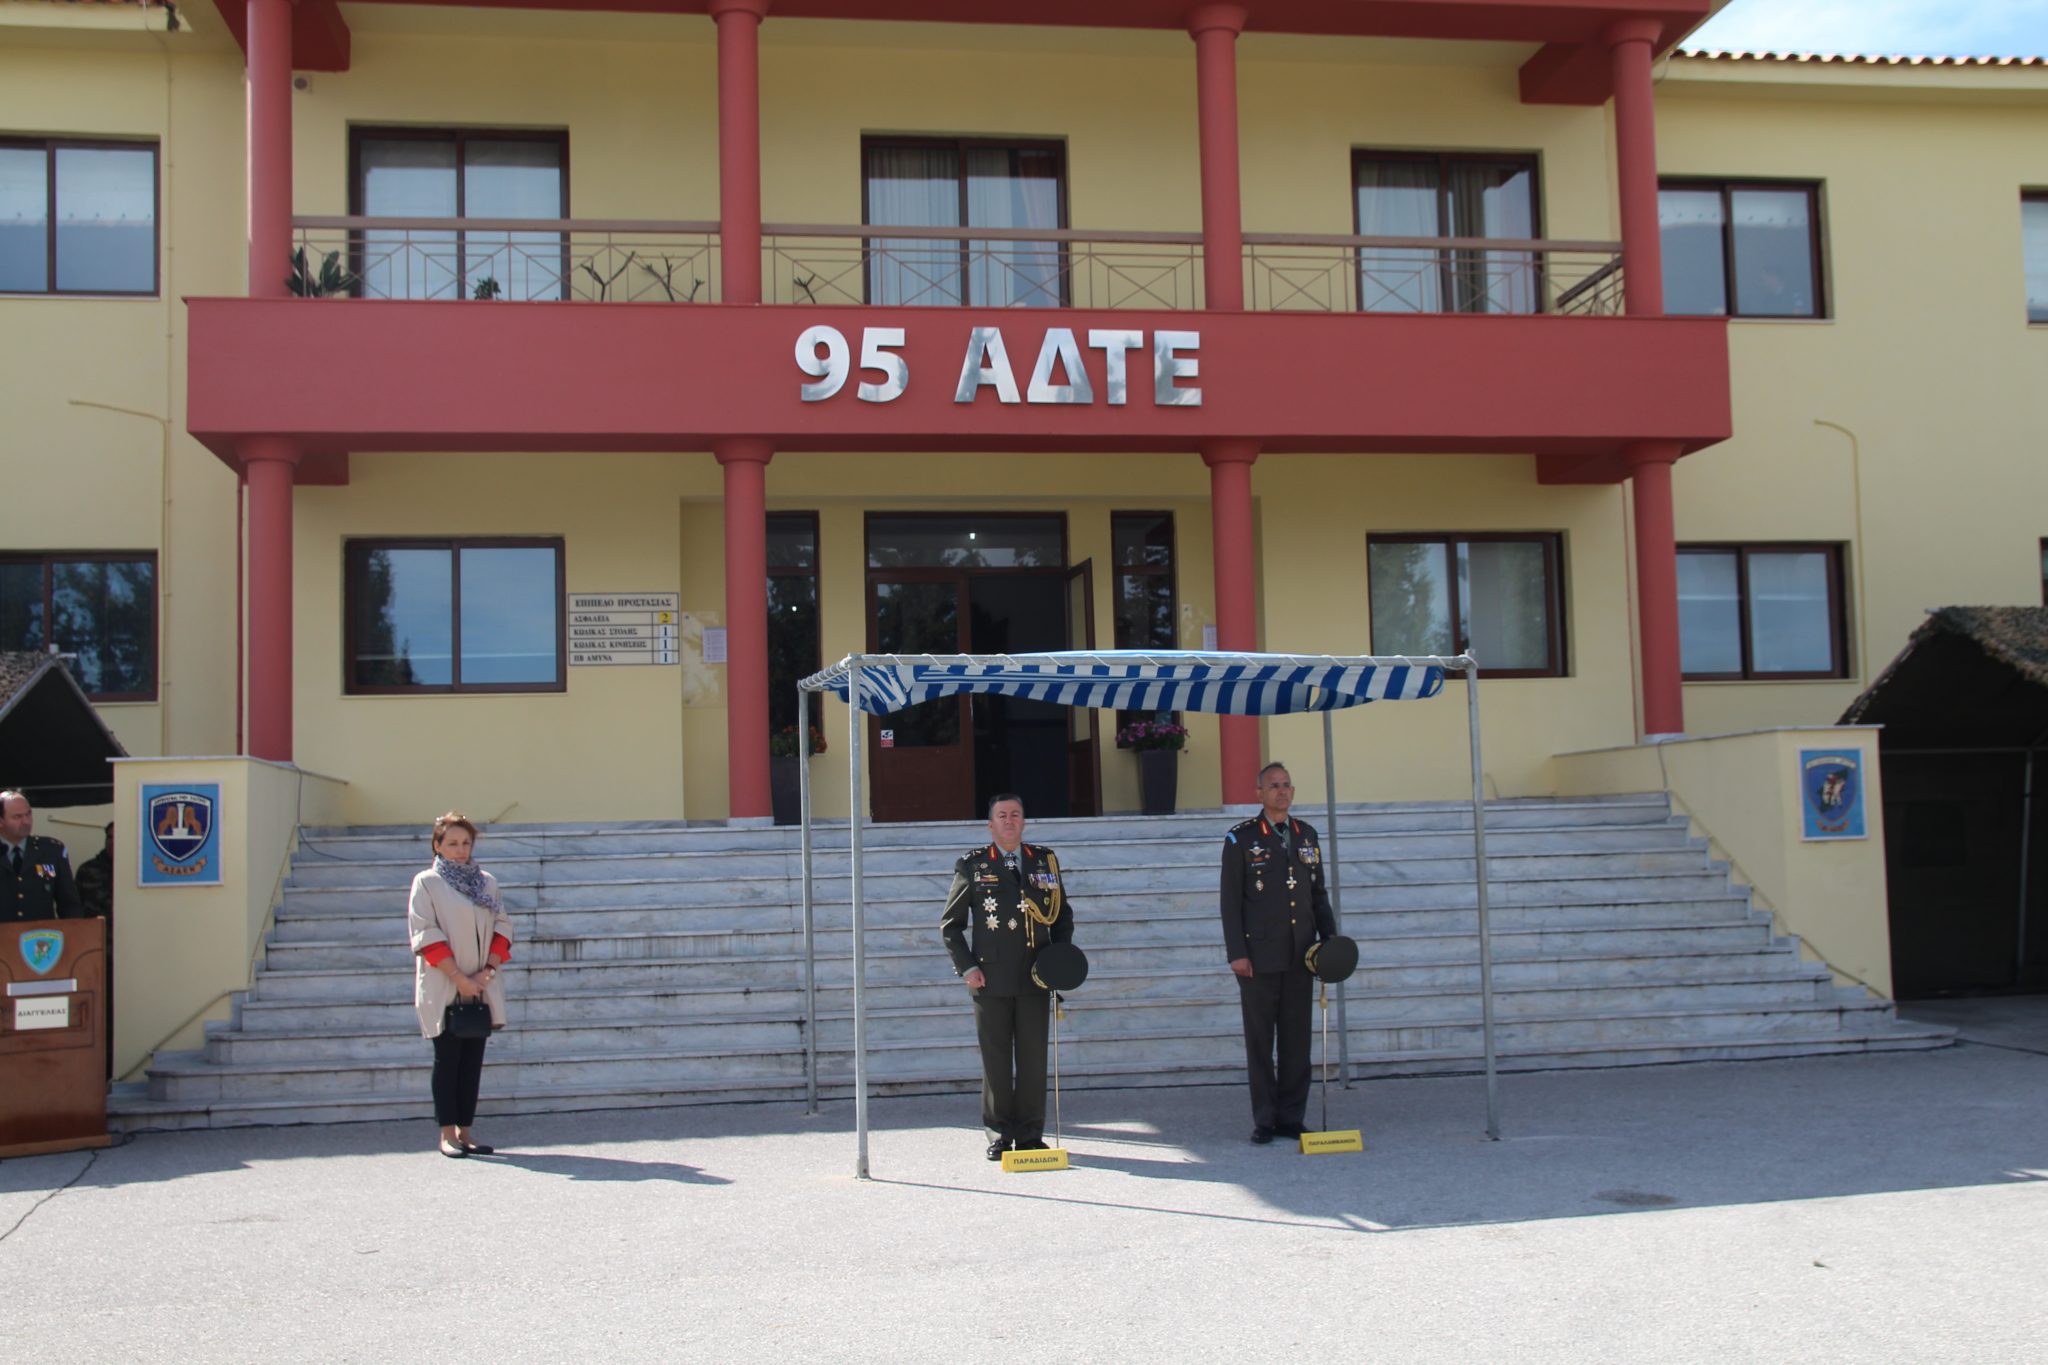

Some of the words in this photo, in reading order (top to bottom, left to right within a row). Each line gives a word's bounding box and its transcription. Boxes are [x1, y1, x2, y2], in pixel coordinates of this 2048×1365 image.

[795, 325, 909, 403] 95
[954, 326, 1201, 405] ΑΔΤΕ
[575, 599, 614, 607] ΕΠΙΠΕΔΟ
[618, 598, 671, 607] ΠΡΟΣΤΑΣΙΑΣ
[662, 613, 669, 623] 2
[574, 628, 606, 636] ΚΩΔΙΚΑΣ
[663, 626, 668, 636] 1
[663, 639, 668, 649] 1
[663, 653, 668, 662] 1
[1013, 1156, 1059, 1165] ΠΑΡΑΔΙΔΩΝ
